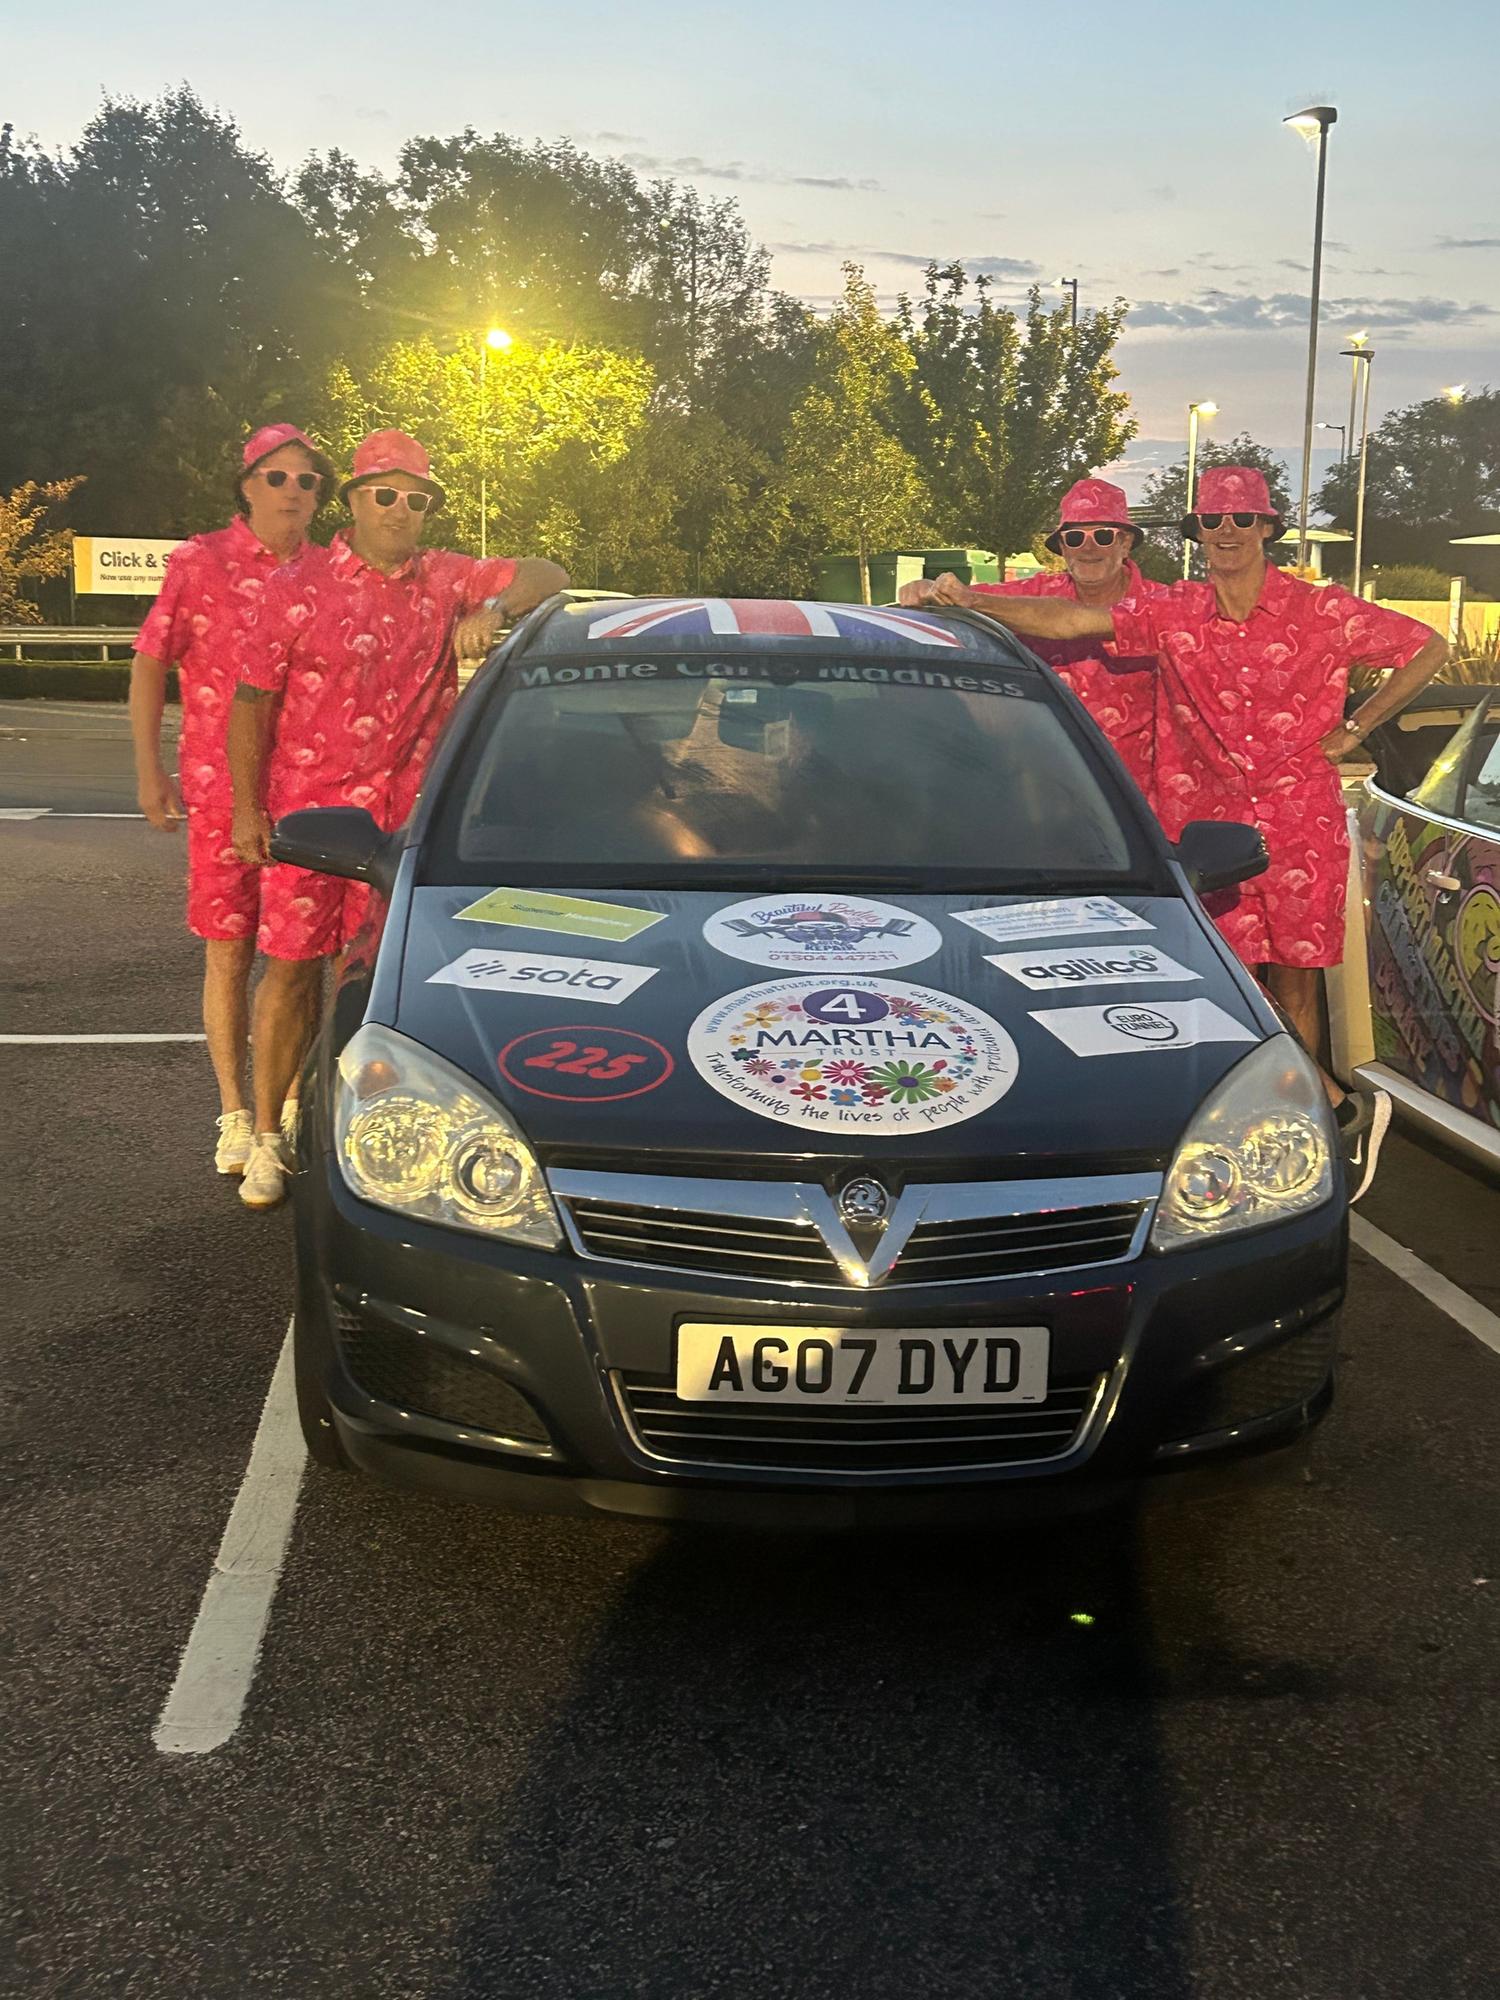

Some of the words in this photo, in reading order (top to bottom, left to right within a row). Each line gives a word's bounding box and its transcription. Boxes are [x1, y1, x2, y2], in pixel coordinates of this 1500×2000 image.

[100, 551, 142, 567] Click
[145, 553, 158, 568] &
[521, 663, 658, 687] Monte
[818, 665, 1025, 698] Madness
[751, 903, 823, 925] Beautiful
[510, 966, 623, 991] sota
[1021, 958, 1159, 981] agilico
[705, 979, 880, 1034] www.marthatrust.org.uk
[820, 993, 867, 1020] 4
[1115, 1014, 1153, 1023] EURO
[1117, 1021, 1172, 1031] TUNNEL
[756, 1028, 952, 1050] MARTHA
[978, 1027, 1010, 1073] profound
[524, 1041, 648, 1080] 225
[816, 1048, 897, 1056] TRUST
[705, 1051, 791, 1116] Transforming
[970, 1073, 994, 1097] with
[800, 1104, 830, 1120] the
[839, 1108, 883, 1122] lives
[893, 1110, 910, 1122] of
[919, 1094, 970, 1123] people
[708, 1336, 877, 1395] AG07
[898, 1338, 1022, 1394] DYD
